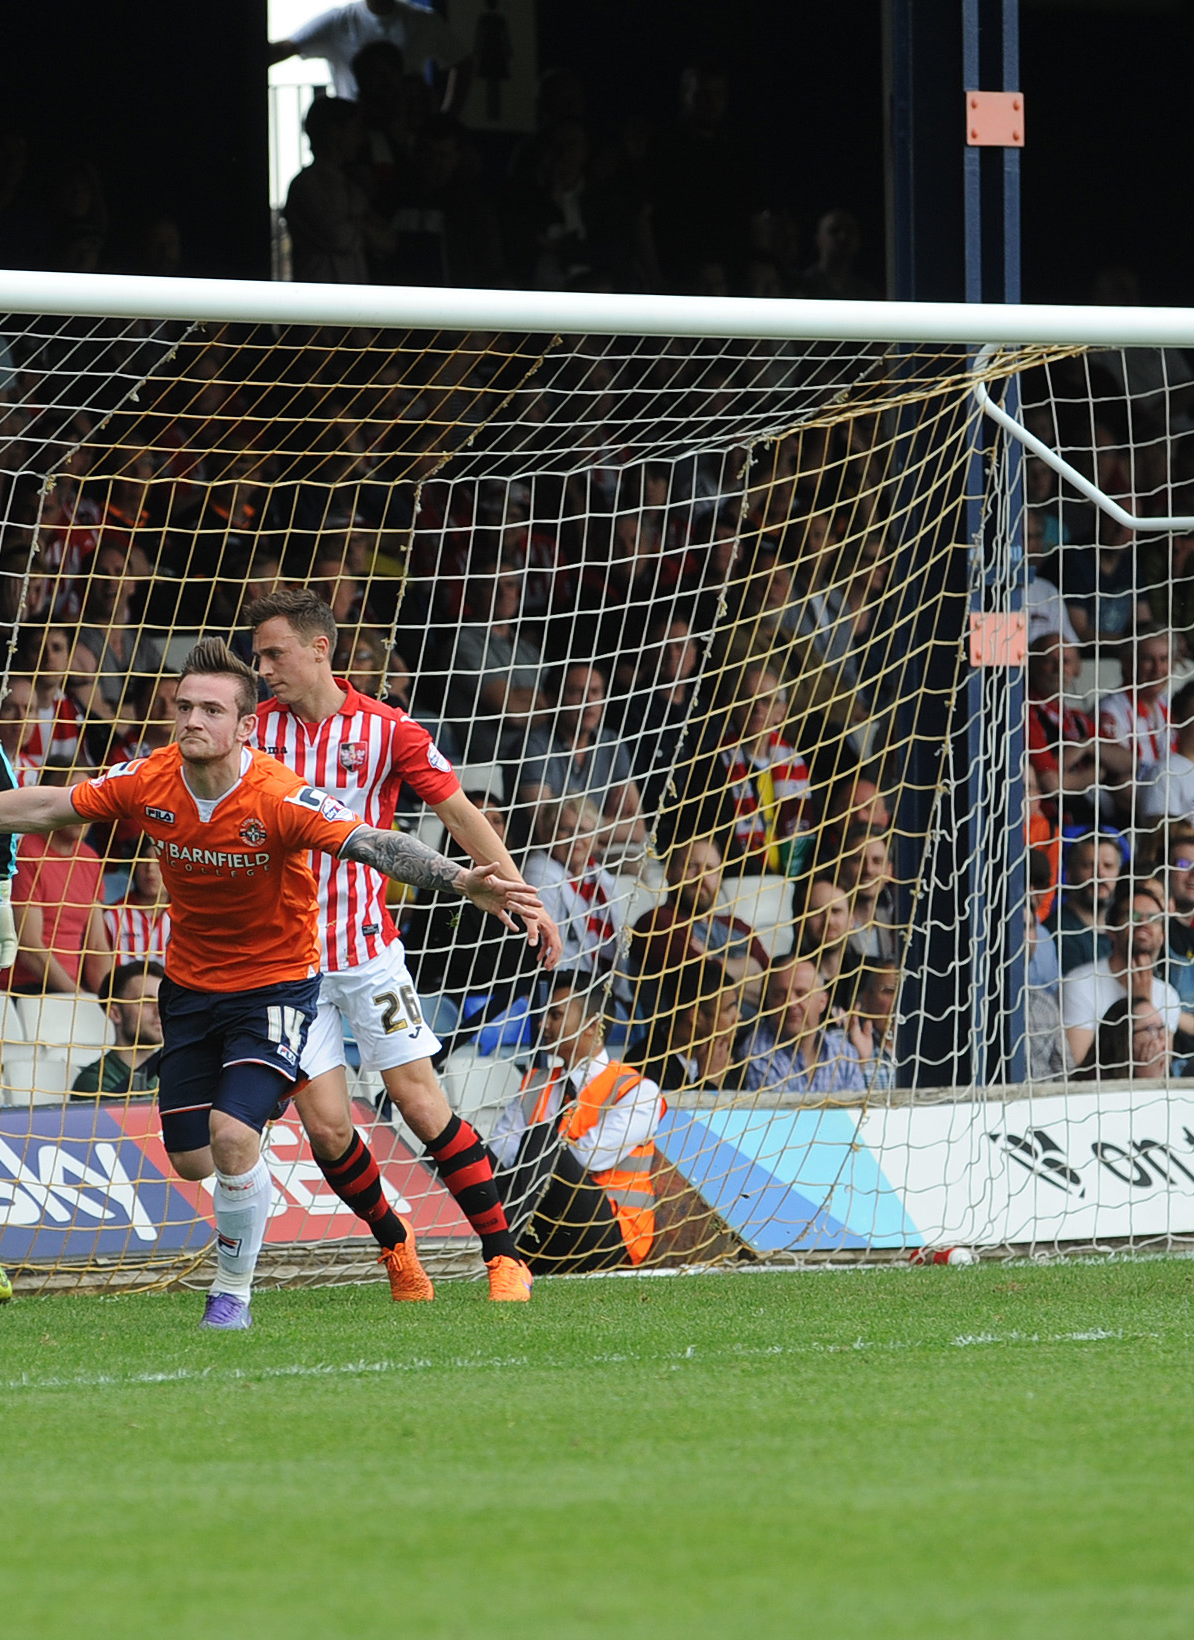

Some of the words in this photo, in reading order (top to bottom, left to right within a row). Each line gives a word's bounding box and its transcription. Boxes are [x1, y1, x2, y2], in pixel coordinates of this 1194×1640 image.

[256, 746, 288, 755] oma
[147, 808, 173, 822] FILA
[169, 843, 270, 867] BARNFIELD
[170, 860, 271, 878] COLLEGE
